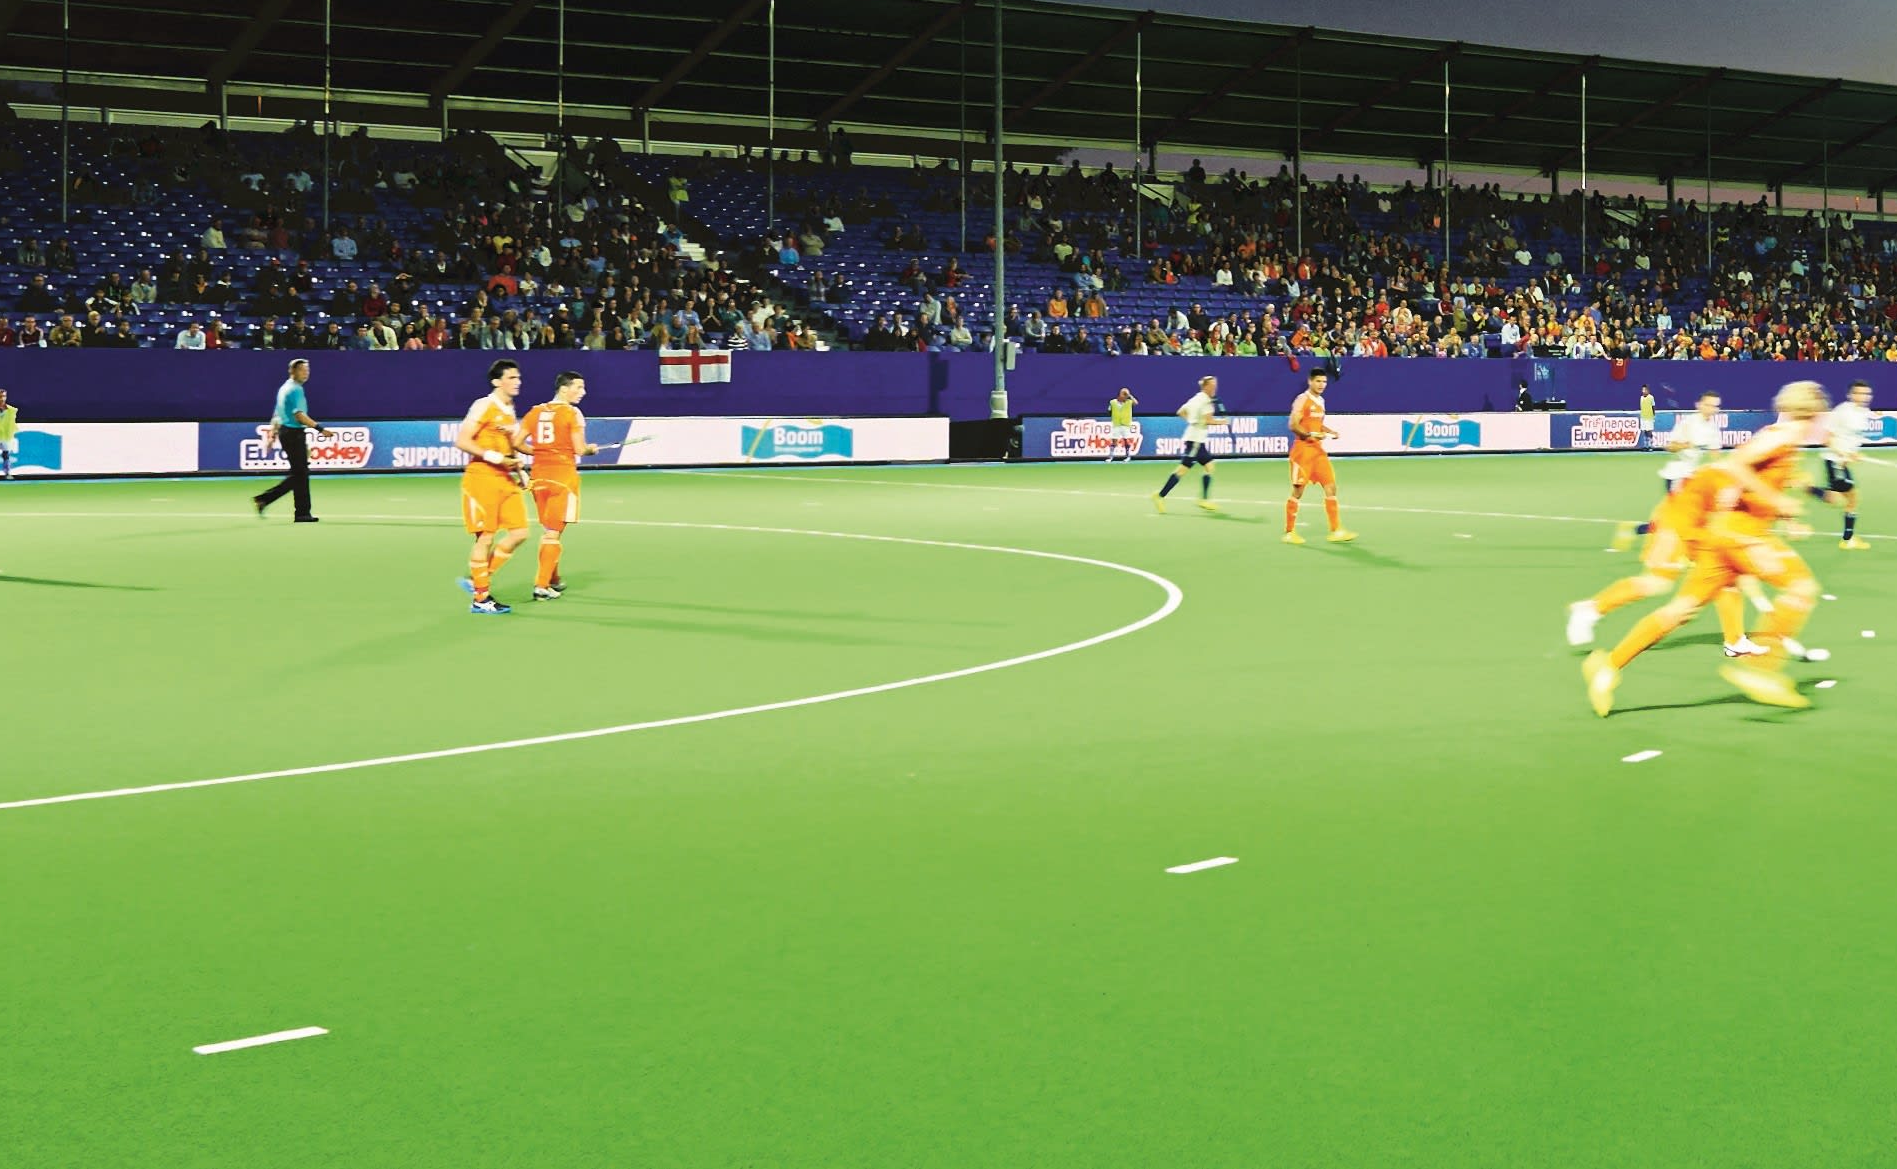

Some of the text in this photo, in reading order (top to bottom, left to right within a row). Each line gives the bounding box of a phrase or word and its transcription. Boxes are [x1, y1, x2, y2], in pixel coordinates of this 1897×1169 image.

[1066, 422, 1138, 435] TriFinae
[1231, 417, 1259, 434] AND
[1424, 421, 1460, 437] Boom
[1582, 417, 1638, 429] TriFinance
[537, 421, 555, 444] 13
[774, 427, 824, 446] Boom
[1574, 429, 1598, 442] Euro
[1599, 429, 1639, 443] Hockey
[1054, 435, 1086, 449] Euro
[1234, 436, 1290, 454] PARTNER
[309, 442, 369, 463] ockey
